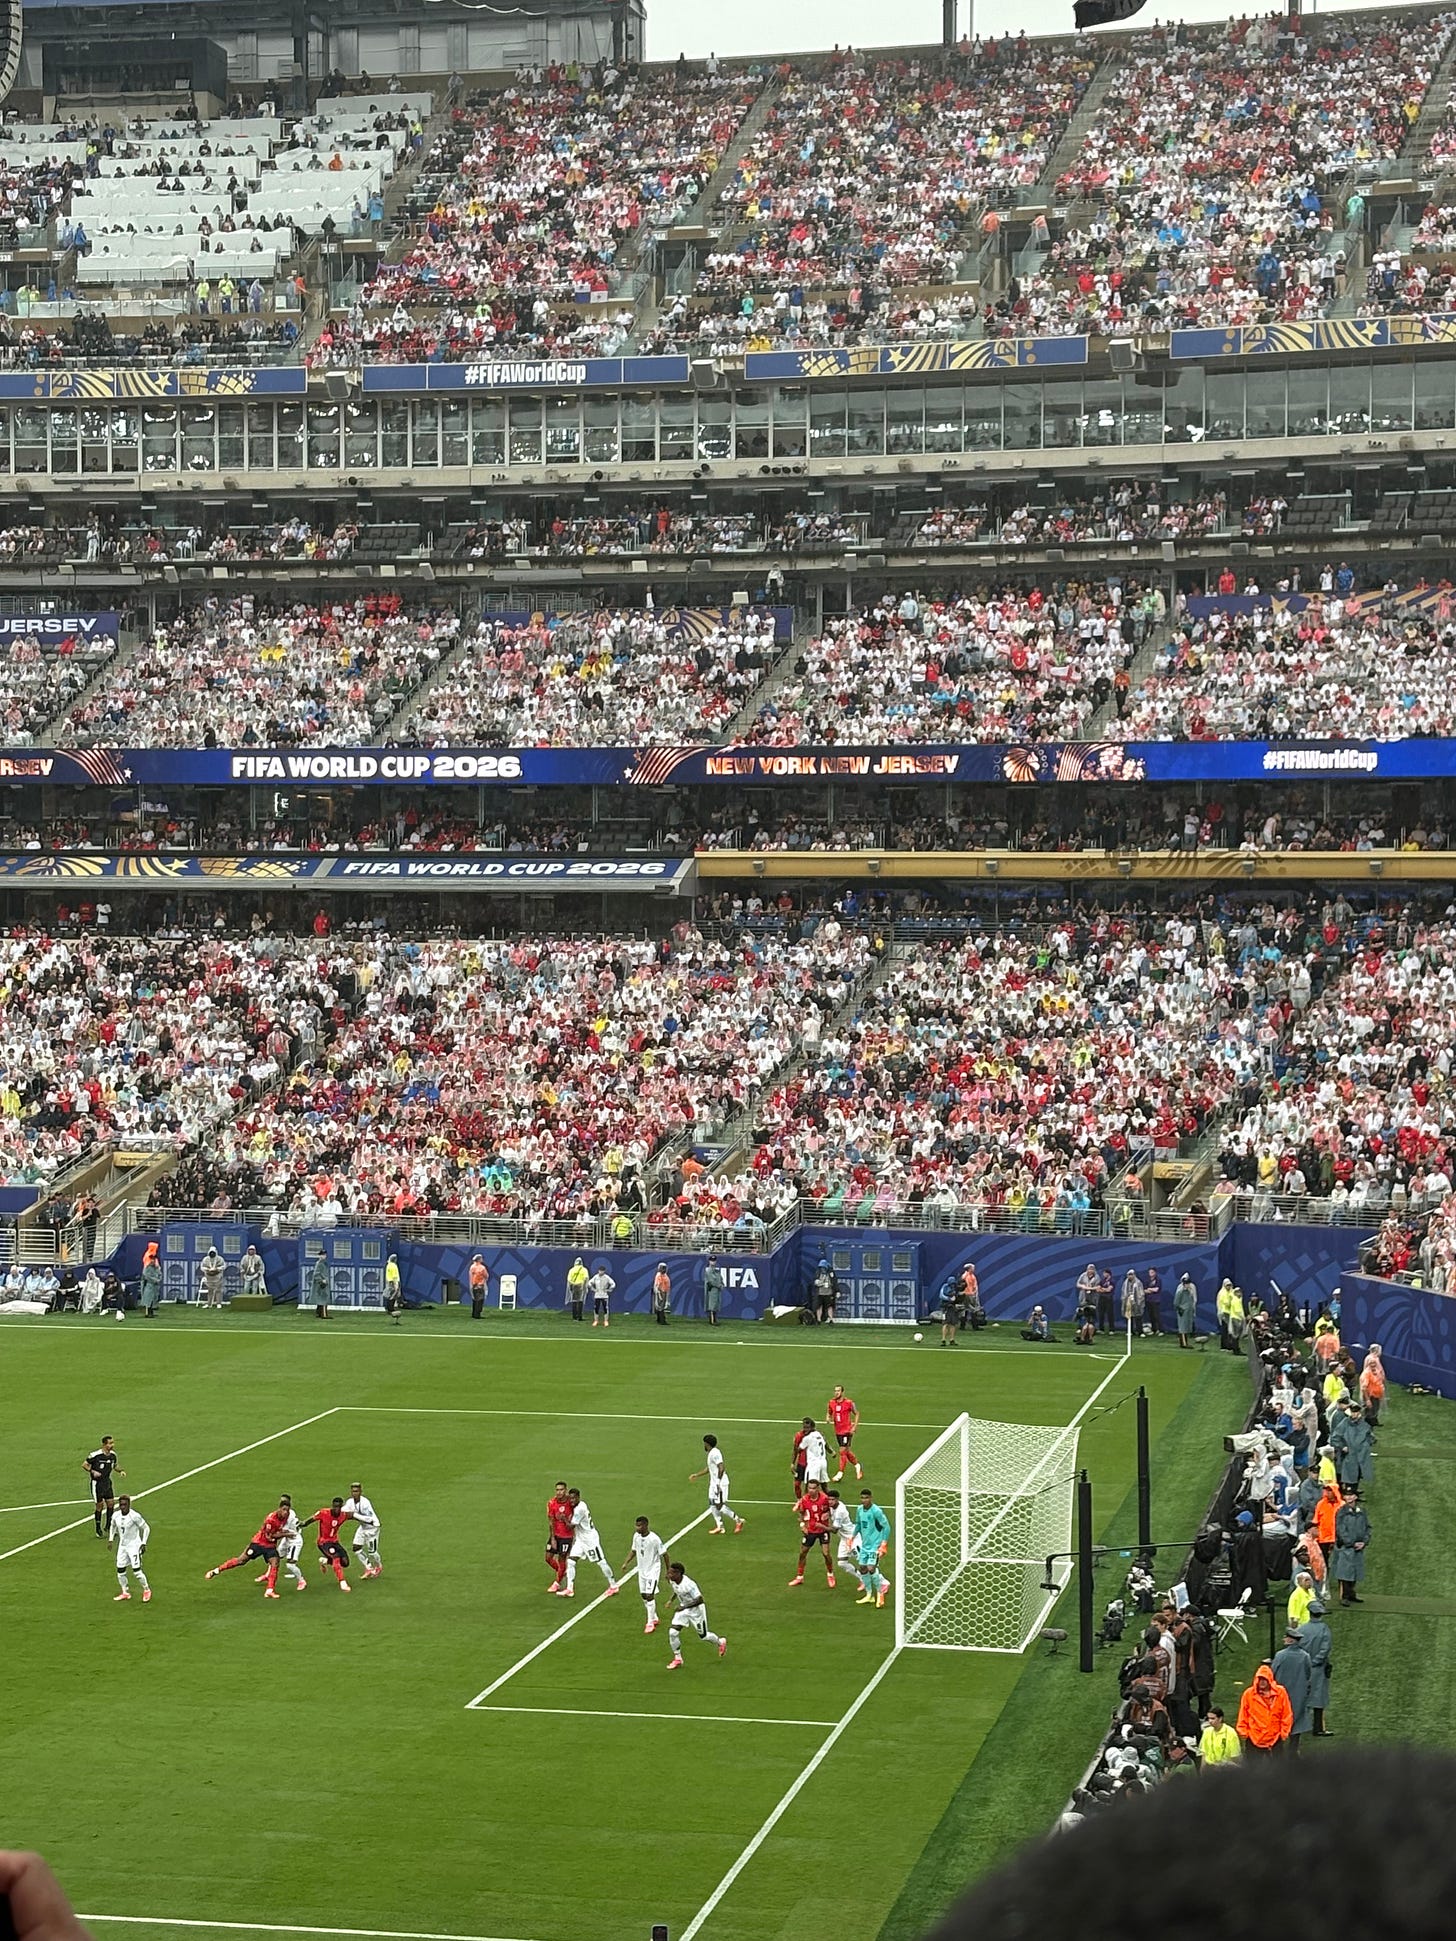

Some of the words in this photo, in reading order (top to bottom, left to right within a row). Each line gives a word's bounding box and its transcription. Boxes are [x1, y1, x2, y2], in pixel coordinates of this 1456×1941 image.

[465, 362, 587, 385] #FIFAWorldCup
[0, 618, 97, 633] JERSEY
[232, 756, 287, 778] FIFA
[288, 756, 378, 778] WORLD
[381, 756, 431, 778] CUP
[433, 756, 521, 778] 2026
[706, 757, 755, 775] NEW
[759, 757, 817, 775] YORK
[820, 756, 870, 774] NEW
[873, 755, 959, 774] JERSEY
[1263, 749, 1378, 771] #FIFAWorldCup
[343, 863, 401, 874] FIFA
[407, 863, 505, 875] WORLD
[508, 863, 565, 875] CUP
[566, 862, 666, 875] 2026
[705, 1267, 759, 1288] IFA
